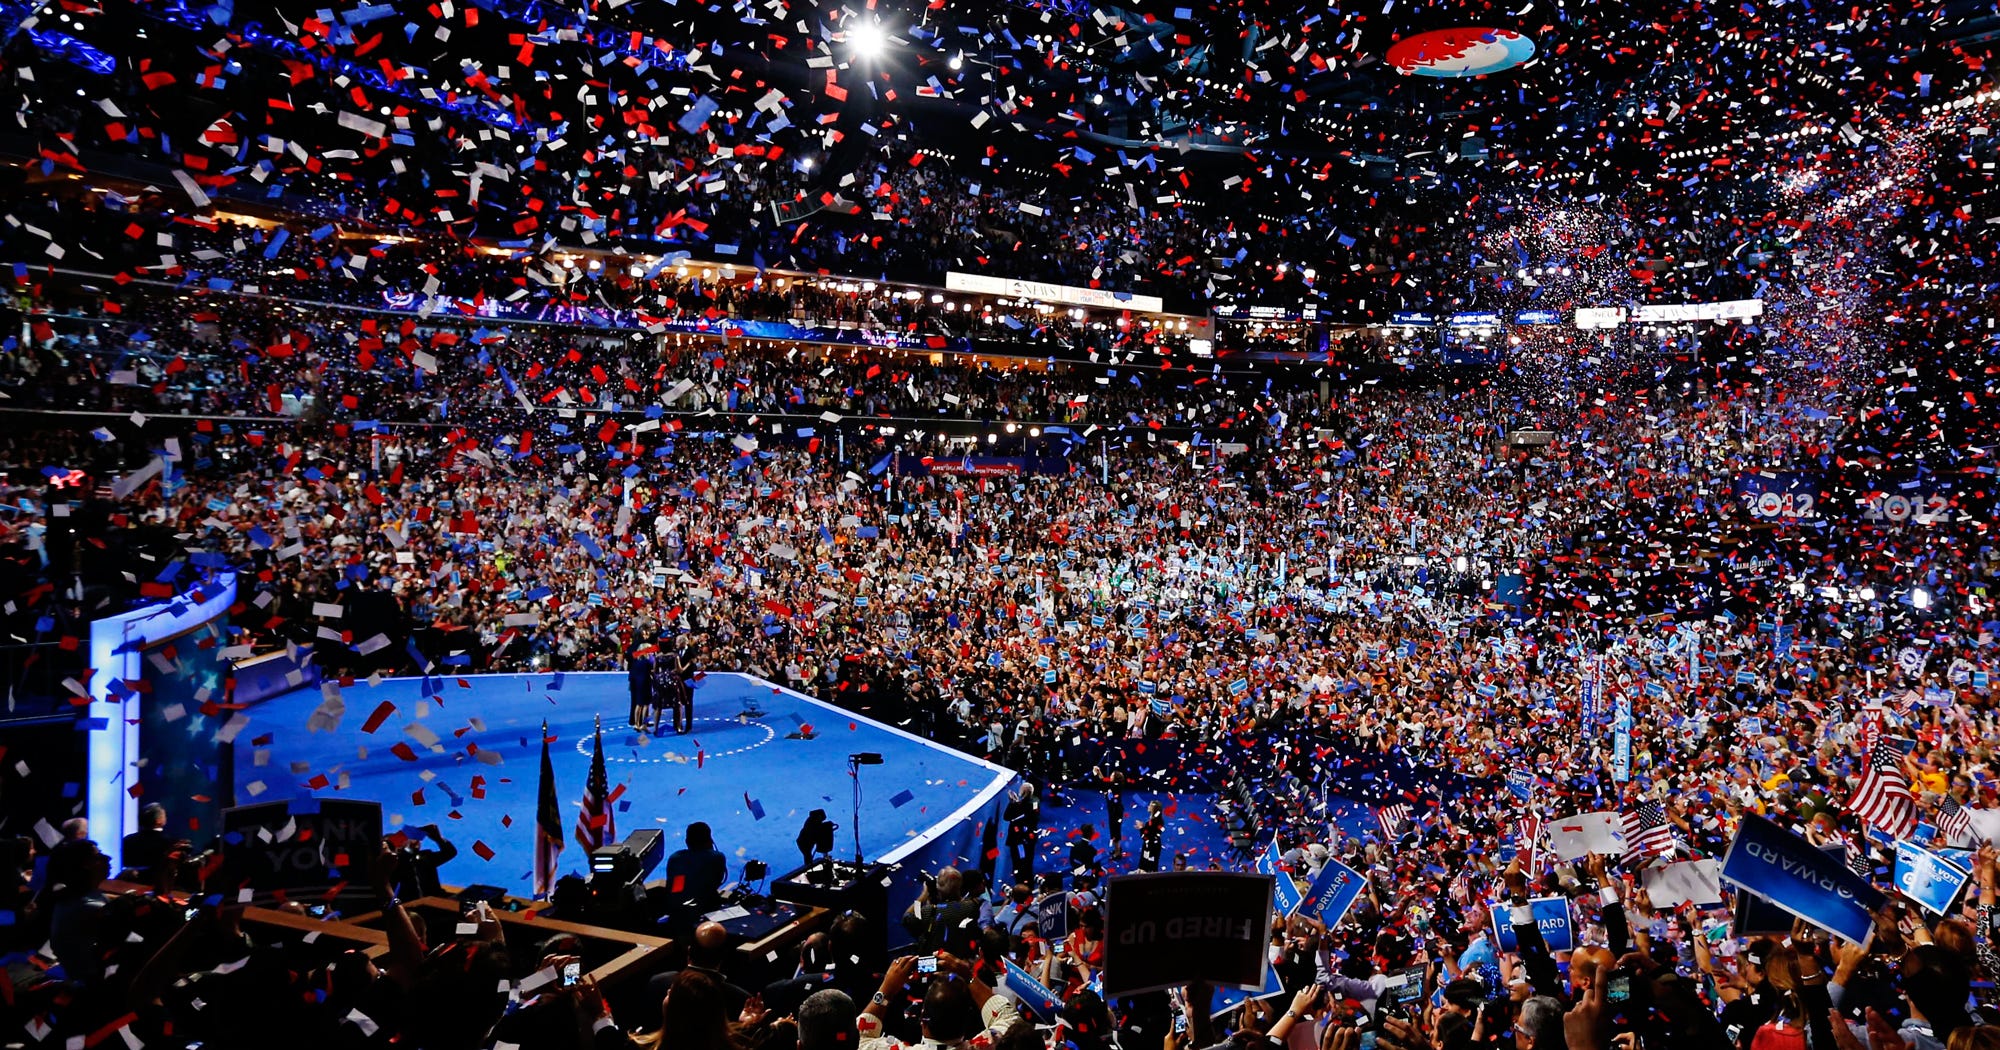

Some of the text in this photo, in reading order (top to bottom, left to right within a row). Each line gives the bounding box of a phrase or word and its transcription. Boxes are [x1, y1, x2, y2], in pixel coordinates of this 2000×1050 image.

[1024, 283, 1057, 297] NEWS
[711, 322, 738, 330] IDEN
[1863, 494, 1950, 522] 2012
[239, 817, 369, 848] TANK
[264, 846, 347, 873] YOU
[1938, 867, 1960, 885] VOTE
[1312, 870, 1347, 915] FORWARD
[1119, 917, 1252, 944] FIRED UP
[1501, 917, 1565, 934] FOARD
